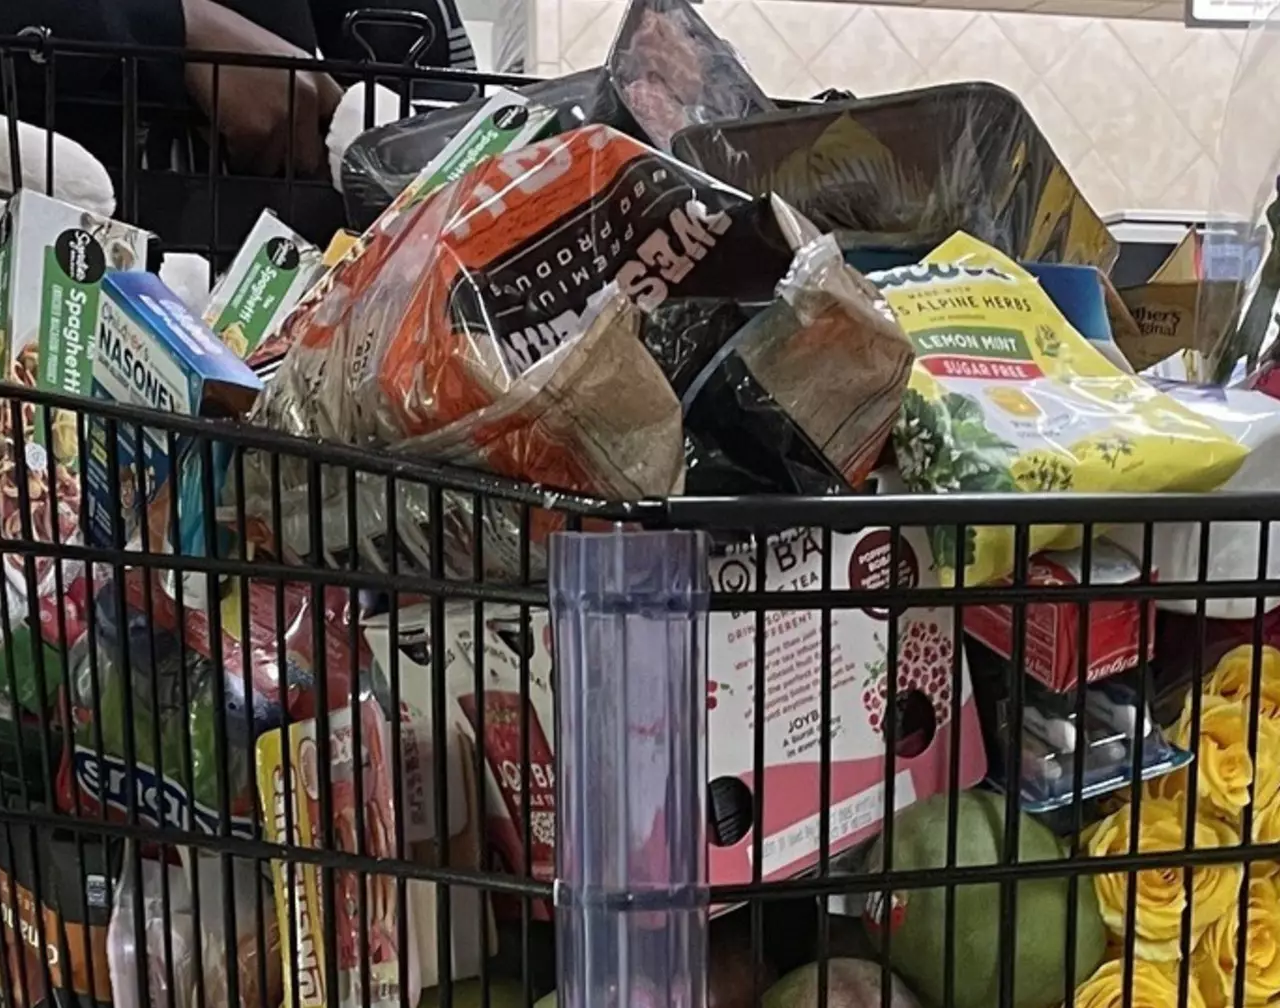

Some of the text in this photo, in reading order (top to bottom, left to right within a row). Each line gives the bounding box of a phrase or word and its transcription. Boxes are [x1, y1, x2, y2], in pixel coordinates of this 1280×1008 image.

[917, 295, 1031, 313] ALPINE HERBS
[63, 288, 86, 394] Spaghetti
[919, 335, 1018, 352] LEMON MINT
[943, 360, 1026, 378] SUGAR FREE
